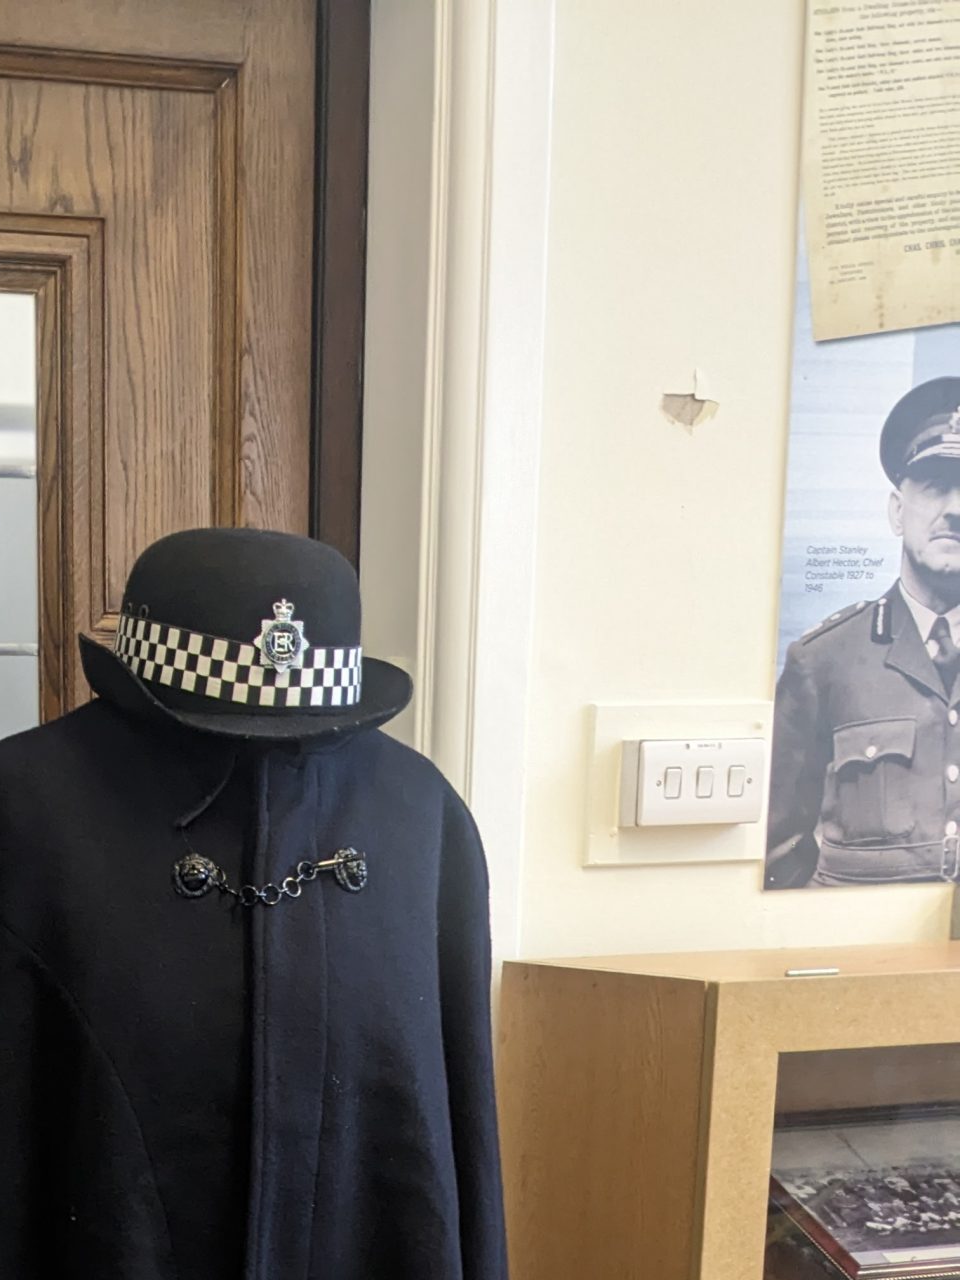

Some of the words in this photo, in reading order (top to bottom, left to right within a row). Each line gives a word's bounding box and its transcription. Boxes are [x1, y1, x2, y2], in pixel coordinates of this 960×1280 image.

[806, 545, 837, 555] Captain
[839, 545, 869, 556] Stanley
[805, 558, 831, 567] Albert
[832, 558, 860, 568] Hector,
[862, 557, 884, 567] Chief
[805, 570, 845, 580] Constable
[846, 570, 865, 580] 1927
[865, 571, 874, 580] to
